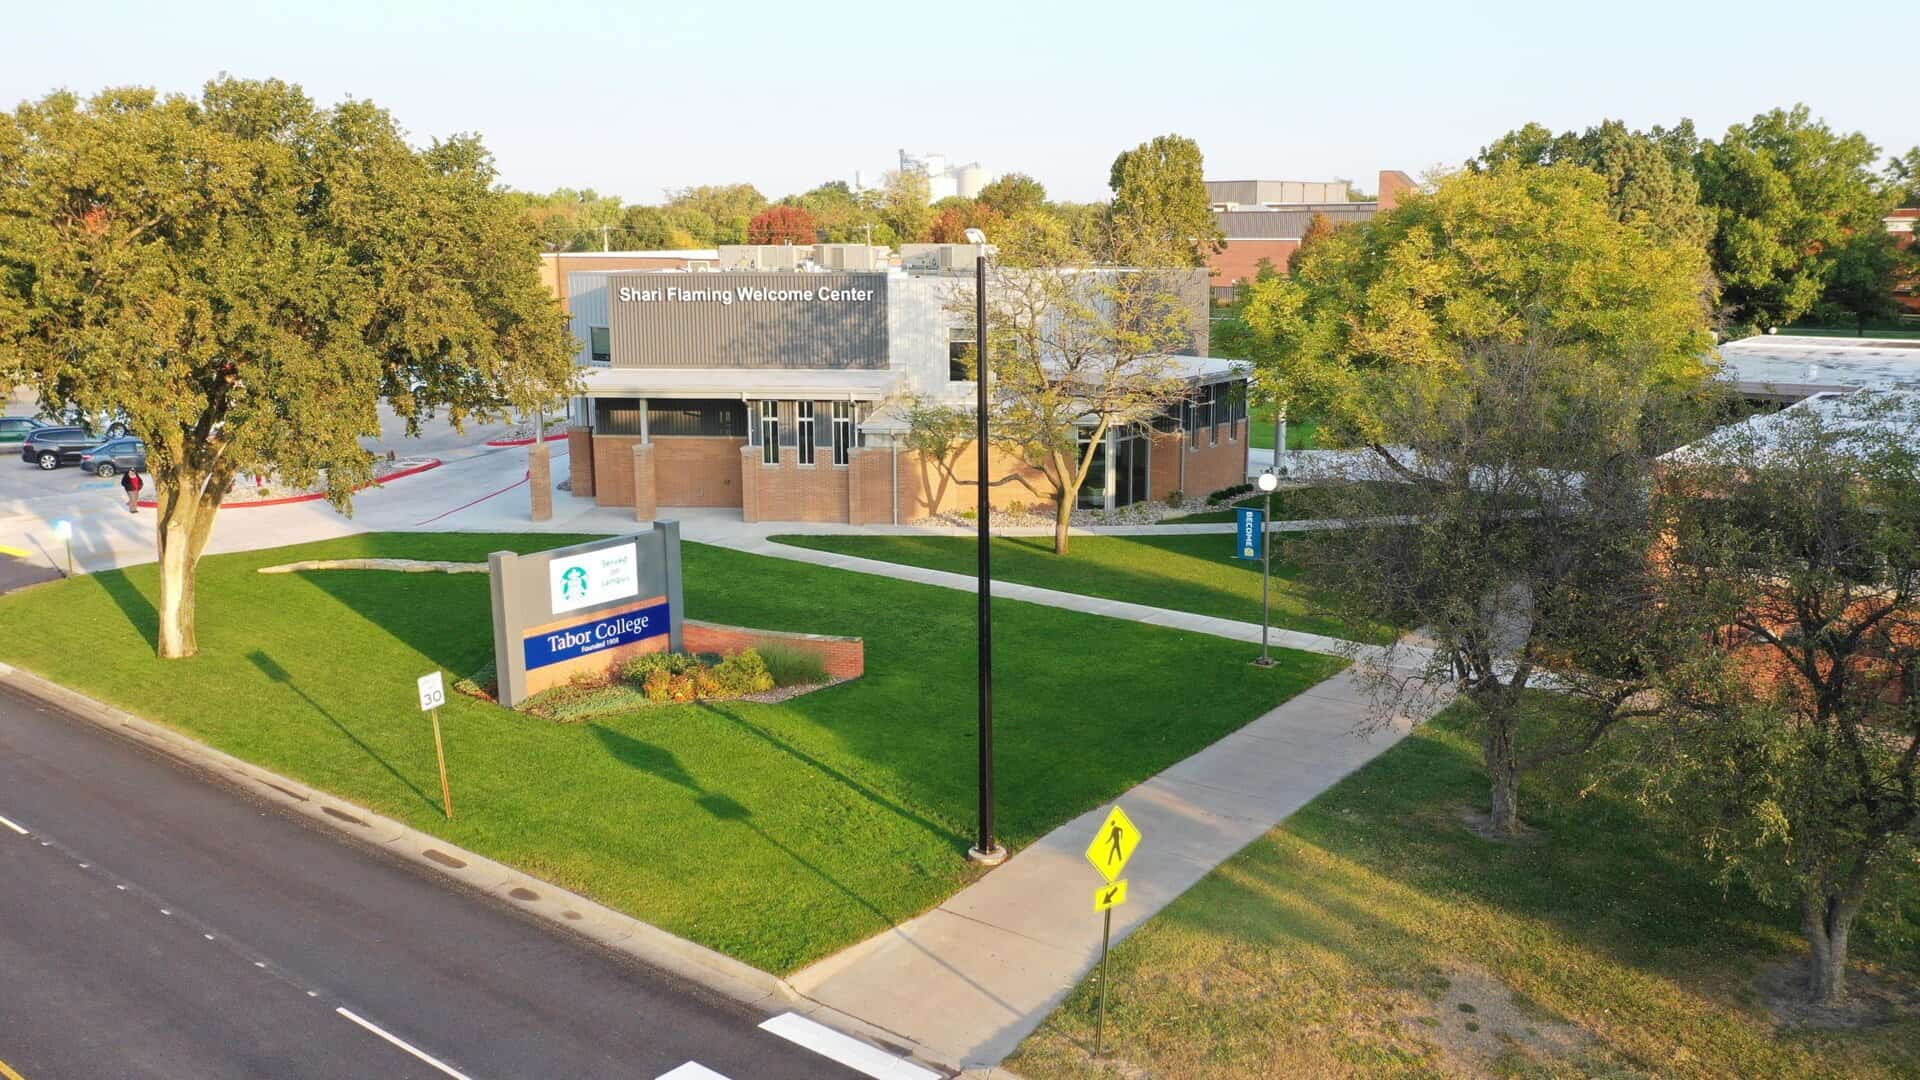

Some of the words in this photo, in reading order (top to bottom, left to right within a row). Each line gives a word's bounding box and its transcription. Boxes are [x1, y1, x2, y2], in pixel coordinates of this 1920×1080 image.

[619, 287, 662, 301] Shari
[667, 287, 732, 304] Flaming
[737, 287, 813, 301] Welcome
[818, 287, 874, 301] Center
[1245, 511, 1253, 547] BECOME
[547, 630, 592, 652] Tabor
[595, 616, 649, 639] College
[581, 640, 606, 653] Founded
[424, 690, 442, 706] 30
